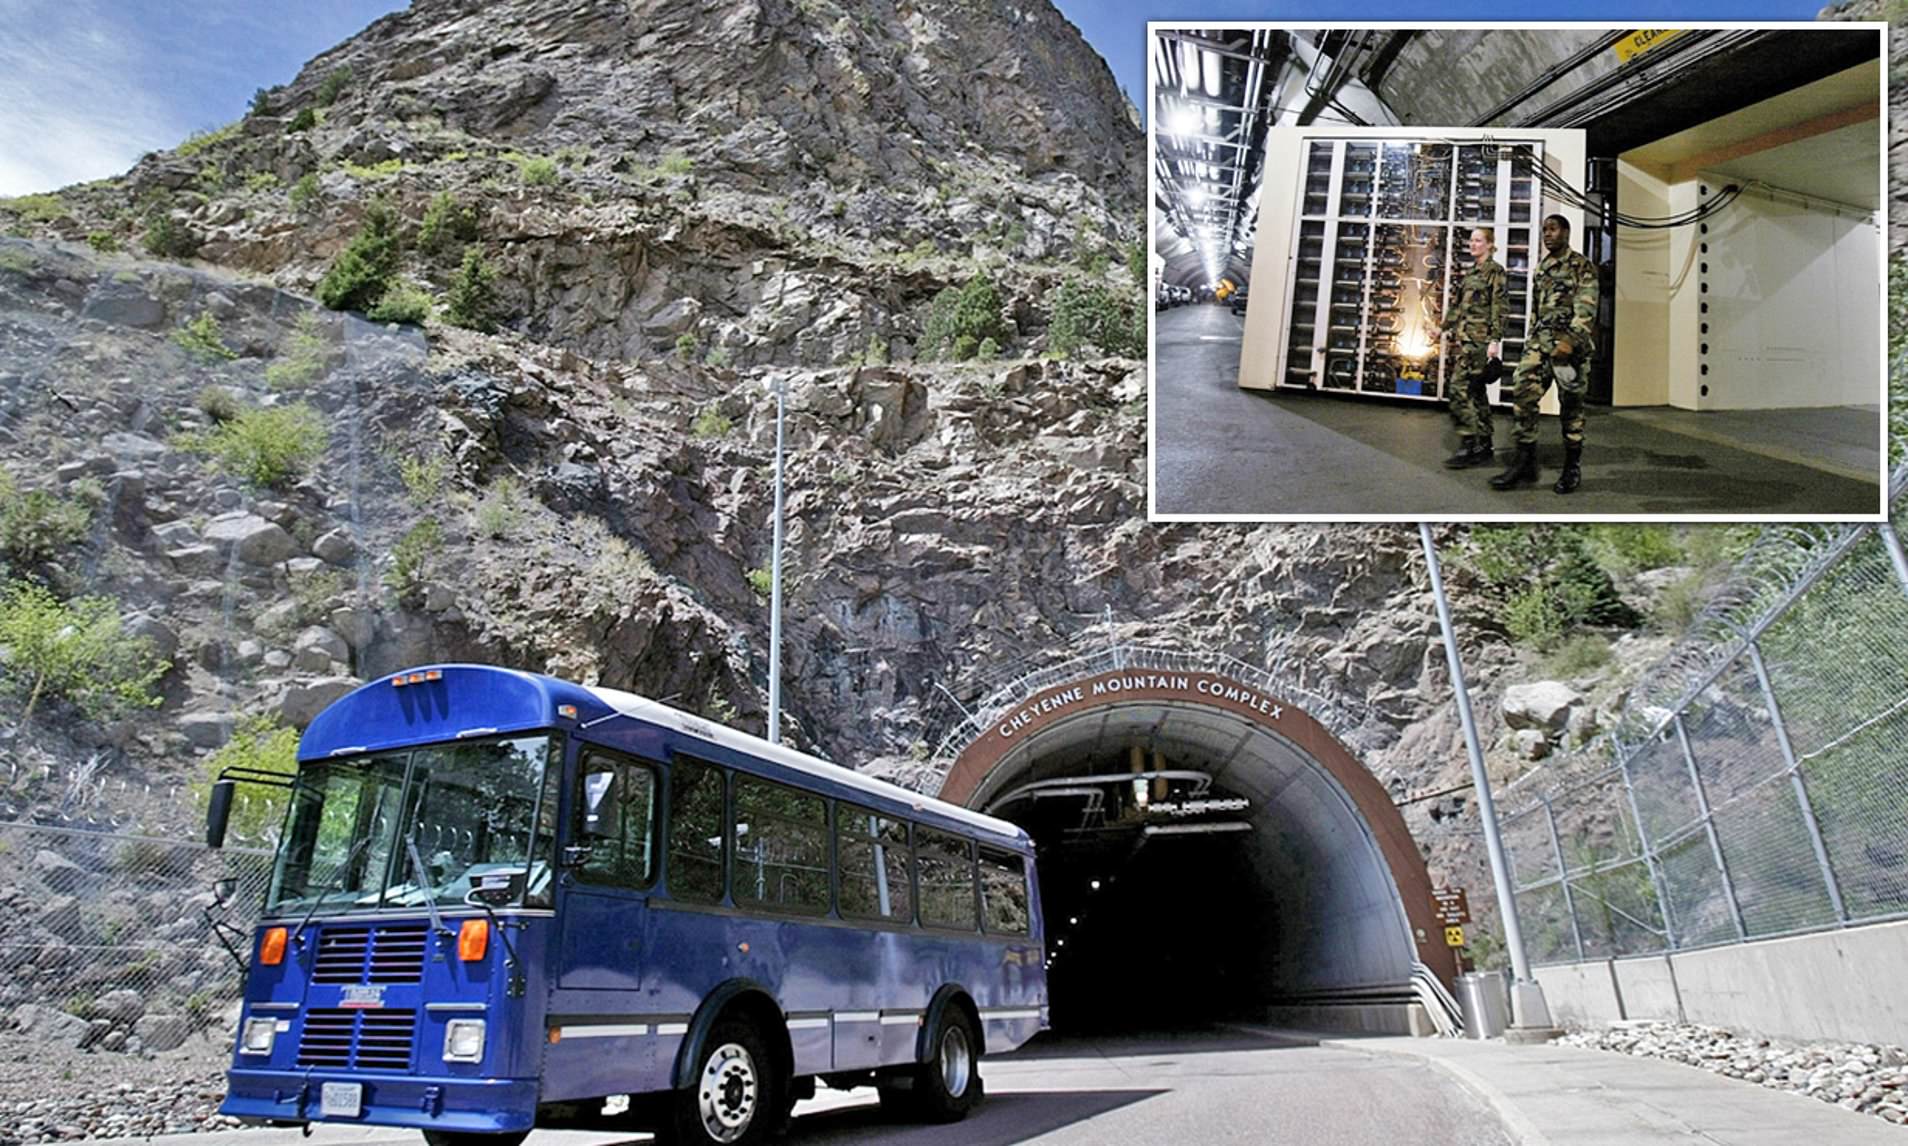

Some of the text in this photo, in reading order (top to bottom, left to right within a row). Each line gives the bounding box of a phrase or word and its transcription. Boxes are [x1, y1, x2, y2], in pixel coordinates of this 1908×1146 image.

[999, 675, 1284, 737] CHEYENNE MOUNTAIN COMPLEX
